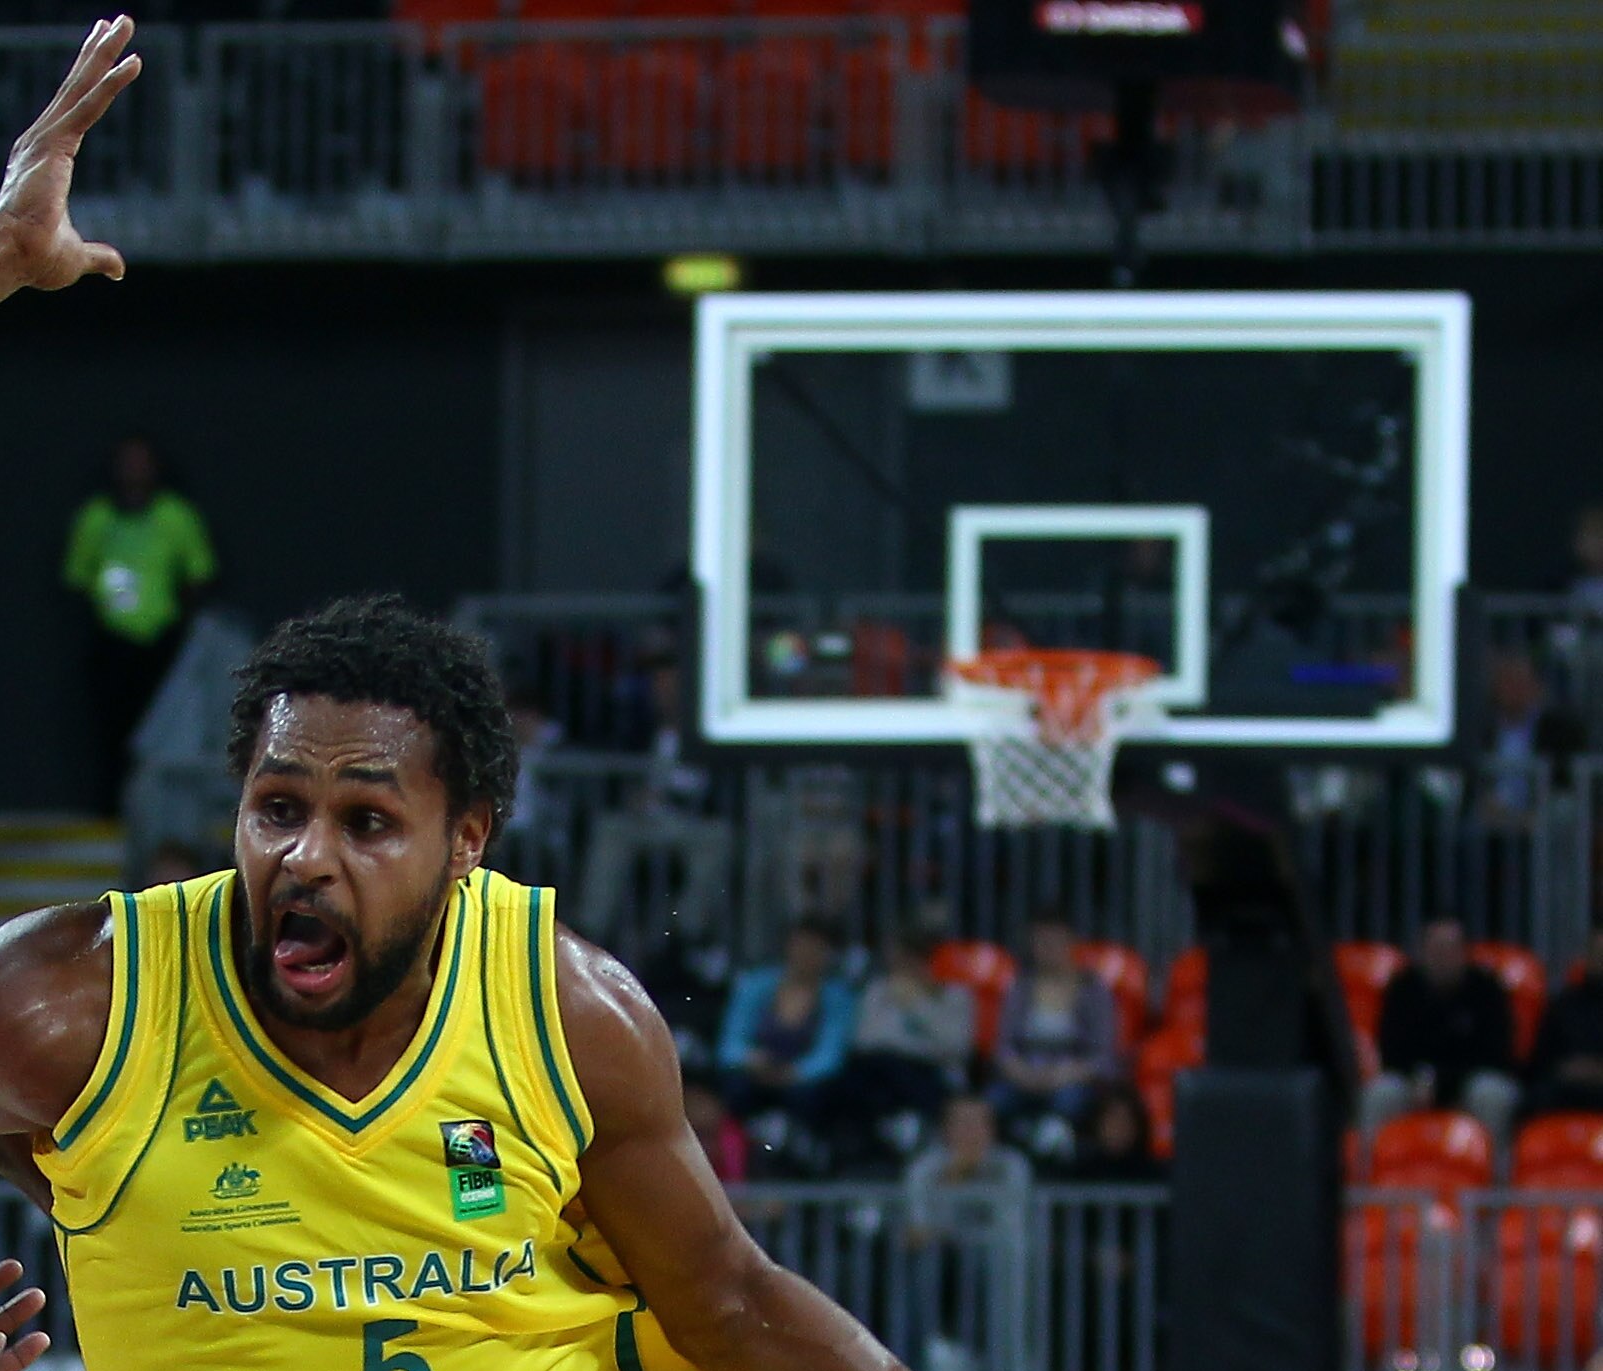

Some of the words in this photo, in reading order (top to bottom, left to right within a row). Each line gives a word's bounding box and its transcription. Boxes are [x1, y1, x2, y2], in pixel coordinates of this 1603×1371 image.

[182, 1110, 259, 1142] PEAK
[459, 1170, 495, 1192] FIBA
[175, 1237, 537, 1316] AUSTRALIA
